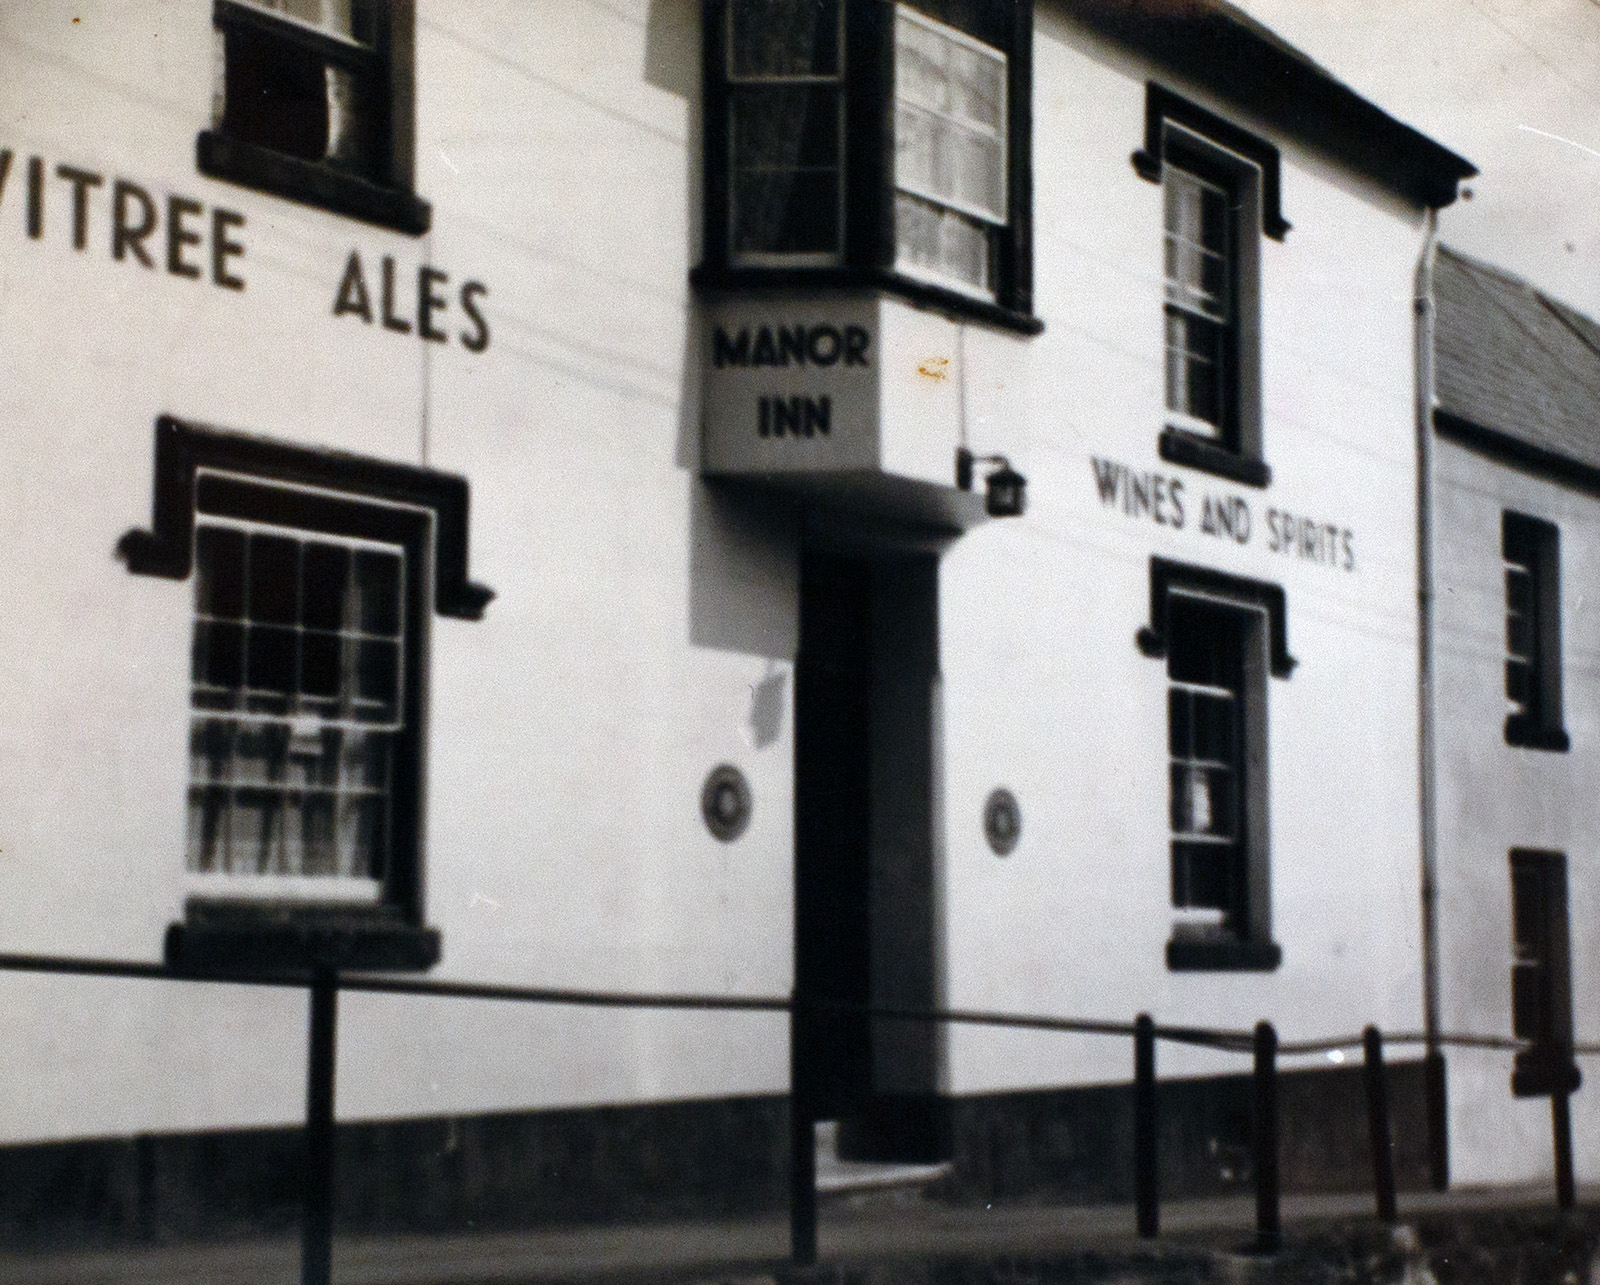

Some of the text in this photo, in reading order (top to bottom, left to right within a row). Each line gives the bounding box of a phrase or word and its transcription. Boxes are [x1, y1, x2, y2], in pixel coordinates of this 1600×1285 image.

[332, 248, 490, 353] ALES
[712, 325, 870, 369] MANOR
[757, 396, 831, 438] INN
[1090, 455, 1354, 572] WINES AND SPIRITS
